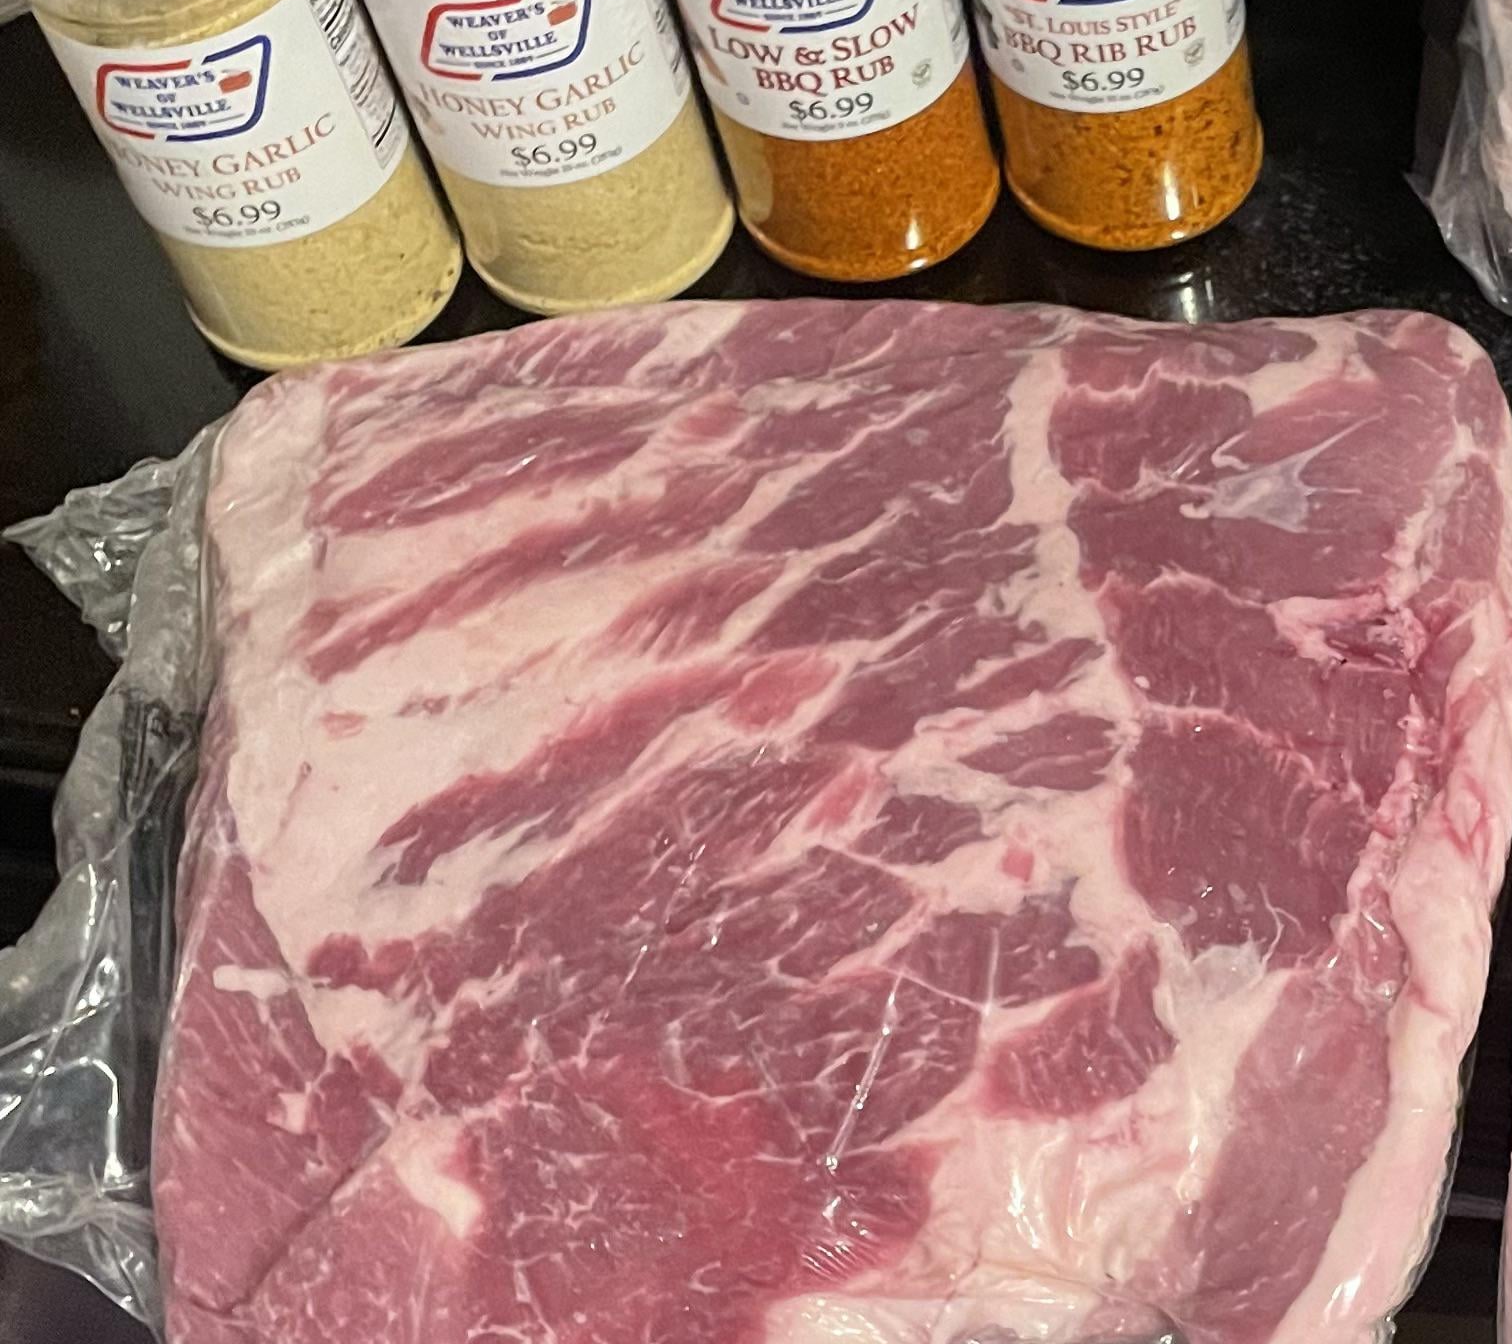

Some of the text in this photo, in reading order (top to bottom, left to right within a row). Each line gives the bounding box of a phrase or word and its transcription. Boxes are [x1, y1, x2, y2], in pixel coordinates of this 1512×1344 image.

[446, 1, 546, 28] WEAVER'S
[1048, 17, 1111, 36] LOUIS
[439, 31, 558, 58] WELLSVILLE
[708, 2, 920, 66] LOW & SLOW
[1002, 15, 1198, 67] BBQ RIB RUB
[114, 70, 217, 89] WEAVER'S
[536, 40, 646, 111] GARLIC
[753, 55, 895, 97] BBQ RUB
[1062, 67, 1145, 93] $6.99
[111, 98, 231, 119] WELLSVILLE
[471, 97, 617, 140] WING RUB
[789, 92, 874, 121] $6.99
[212, 112, 336, 176] GARLIC
[511, 132, 598, 168] $6.99
[152, 166, 301, 200] WING RUB
[193, 200, 281, 228] $6.99
